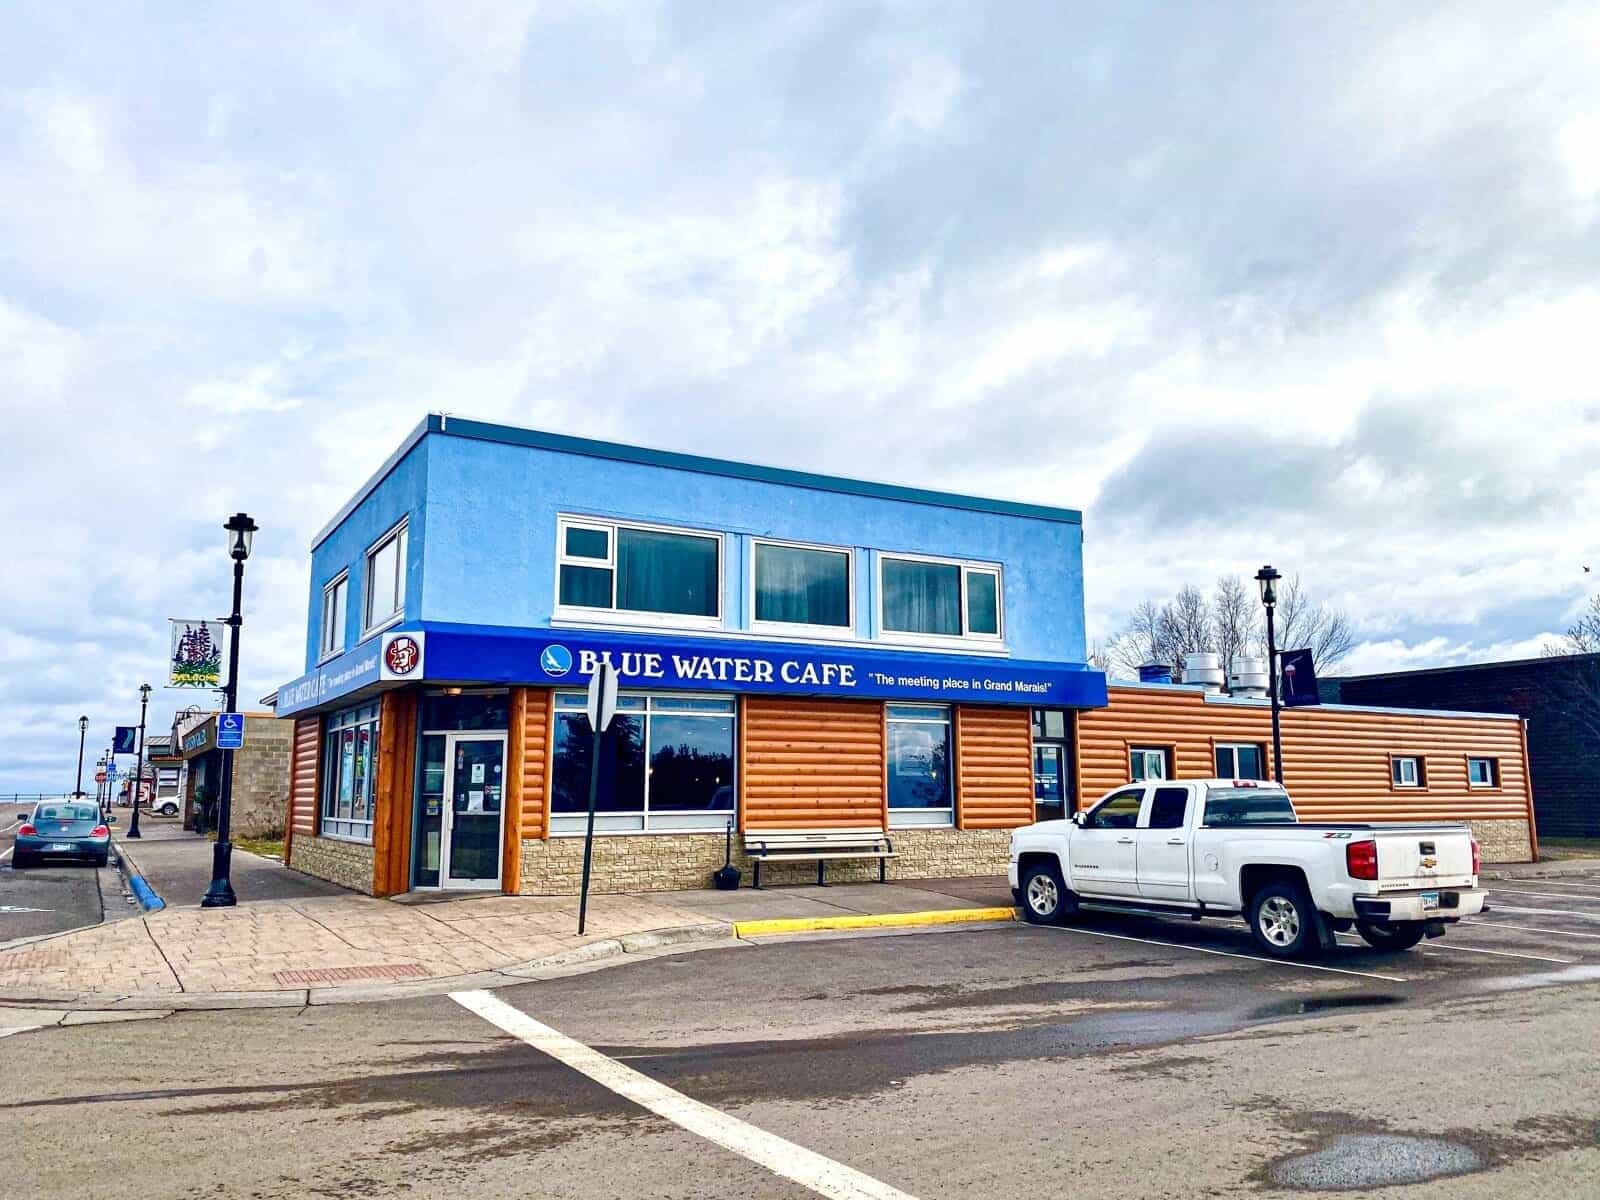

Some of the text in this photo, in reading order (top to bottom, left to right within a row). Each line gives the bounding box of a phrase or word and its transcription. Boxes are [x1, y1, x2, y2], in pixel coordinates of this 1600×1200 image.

[578, 649, 857, 687] BLUE WATER CAFE
[897, 676, 940, 690] meeting
[942, 677, 969, 690] place
[971, 678, 981, 689] in
[983, 679, 1013, 692] Grand
